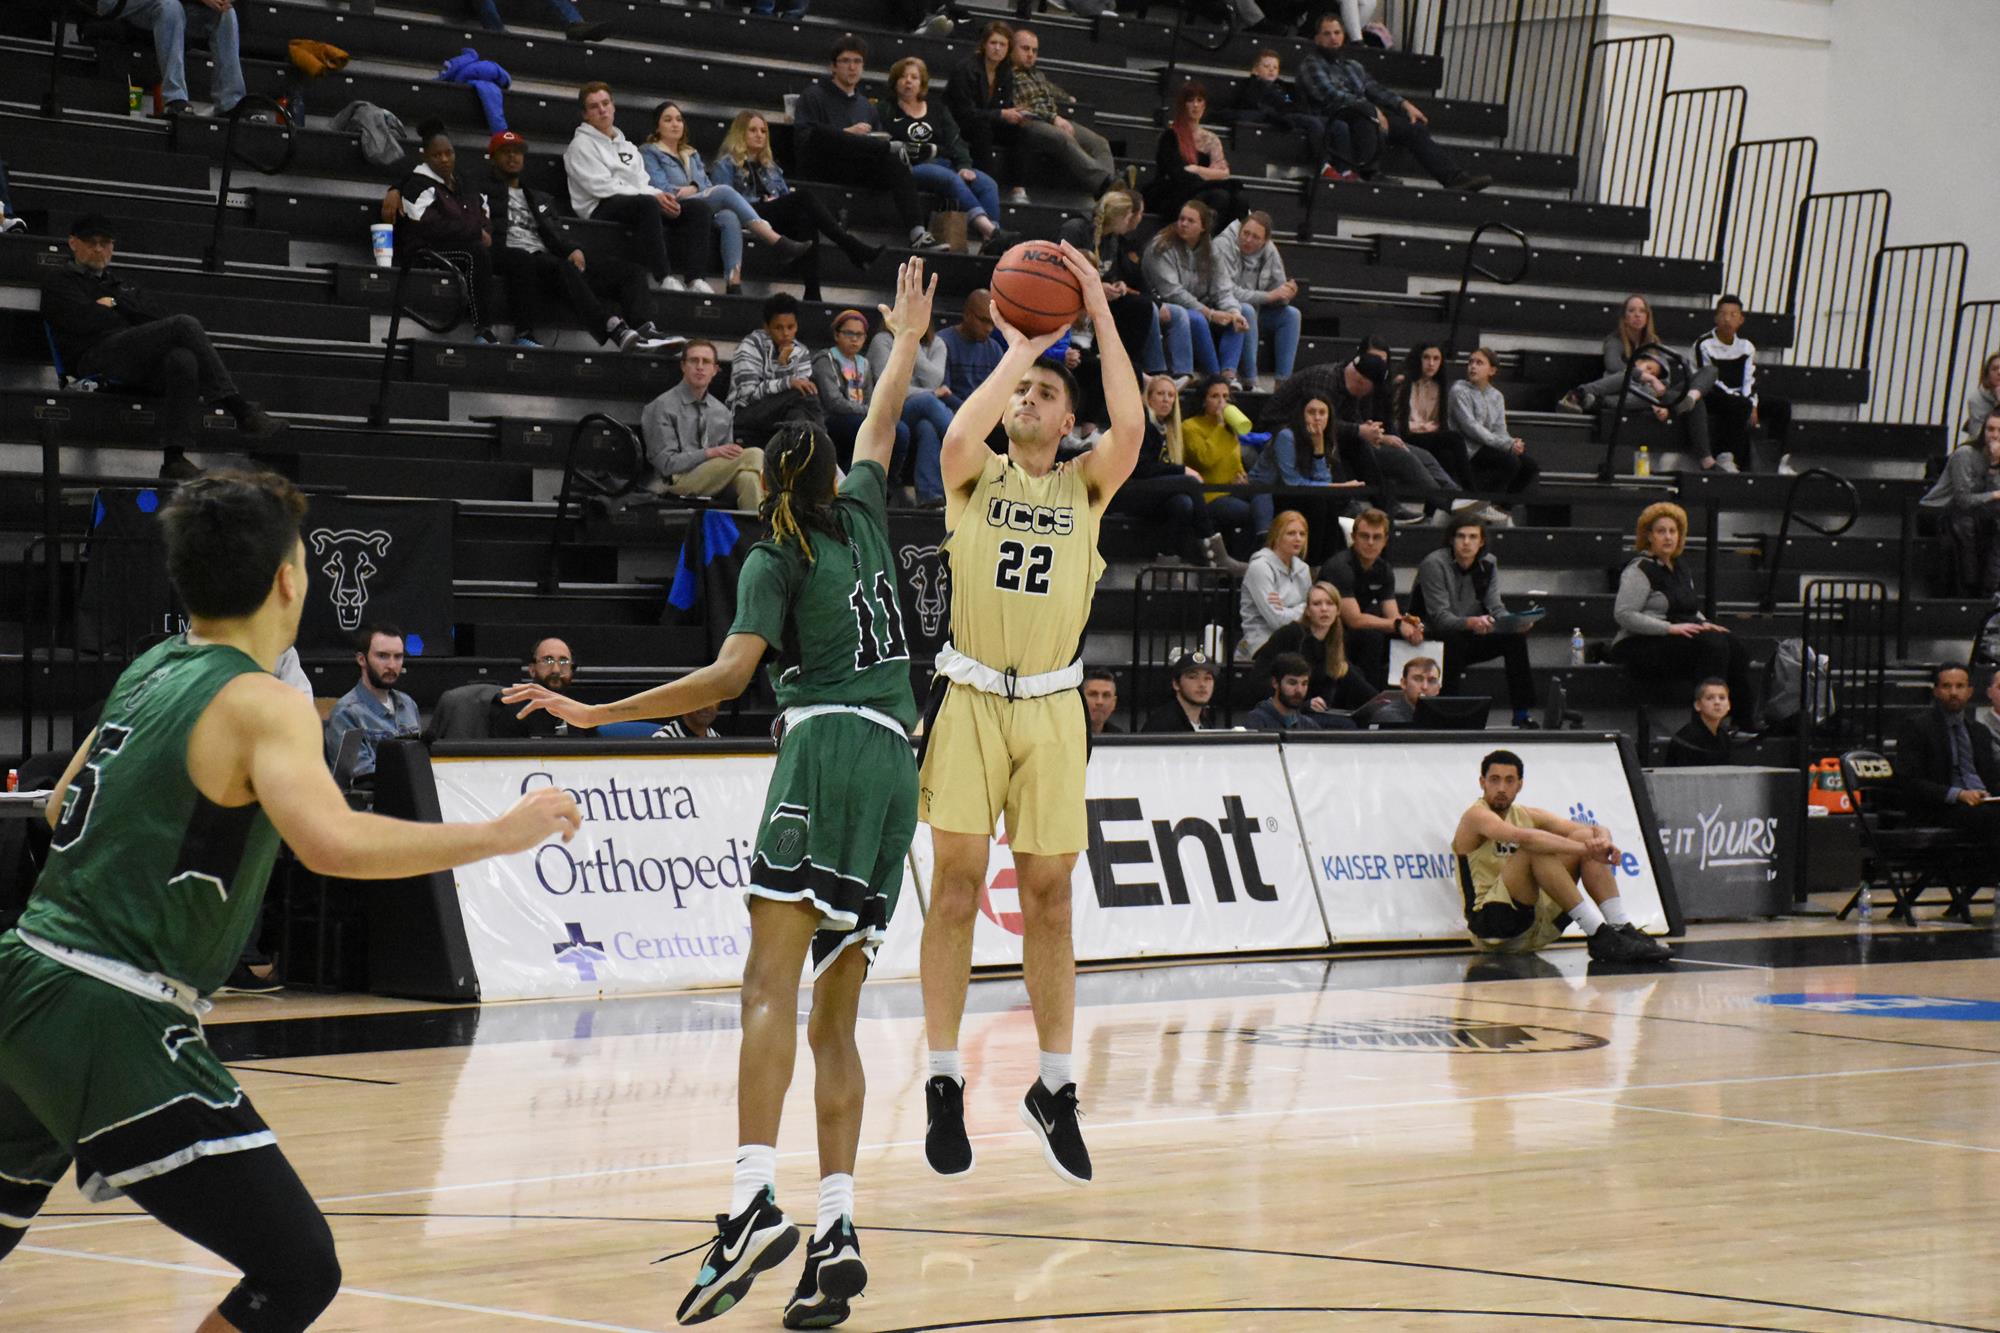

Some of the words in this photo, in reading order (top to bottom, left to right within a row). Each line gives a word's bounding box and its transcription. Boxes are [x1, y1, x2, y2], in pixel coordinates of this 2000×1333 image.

[986, 497, 1074, 536] UCCS
[995, 539, 1055, 596] 22
[849, 570, 910, 671] 11
[1849, 759, 1893, 778] UCCS
[1675, 828, 1696, 855] IT
[1697, 803, 1778, 871] YOURS
[1321, 854, 1399, 881] KAISER
[613, 930, 741, 961] Centura
